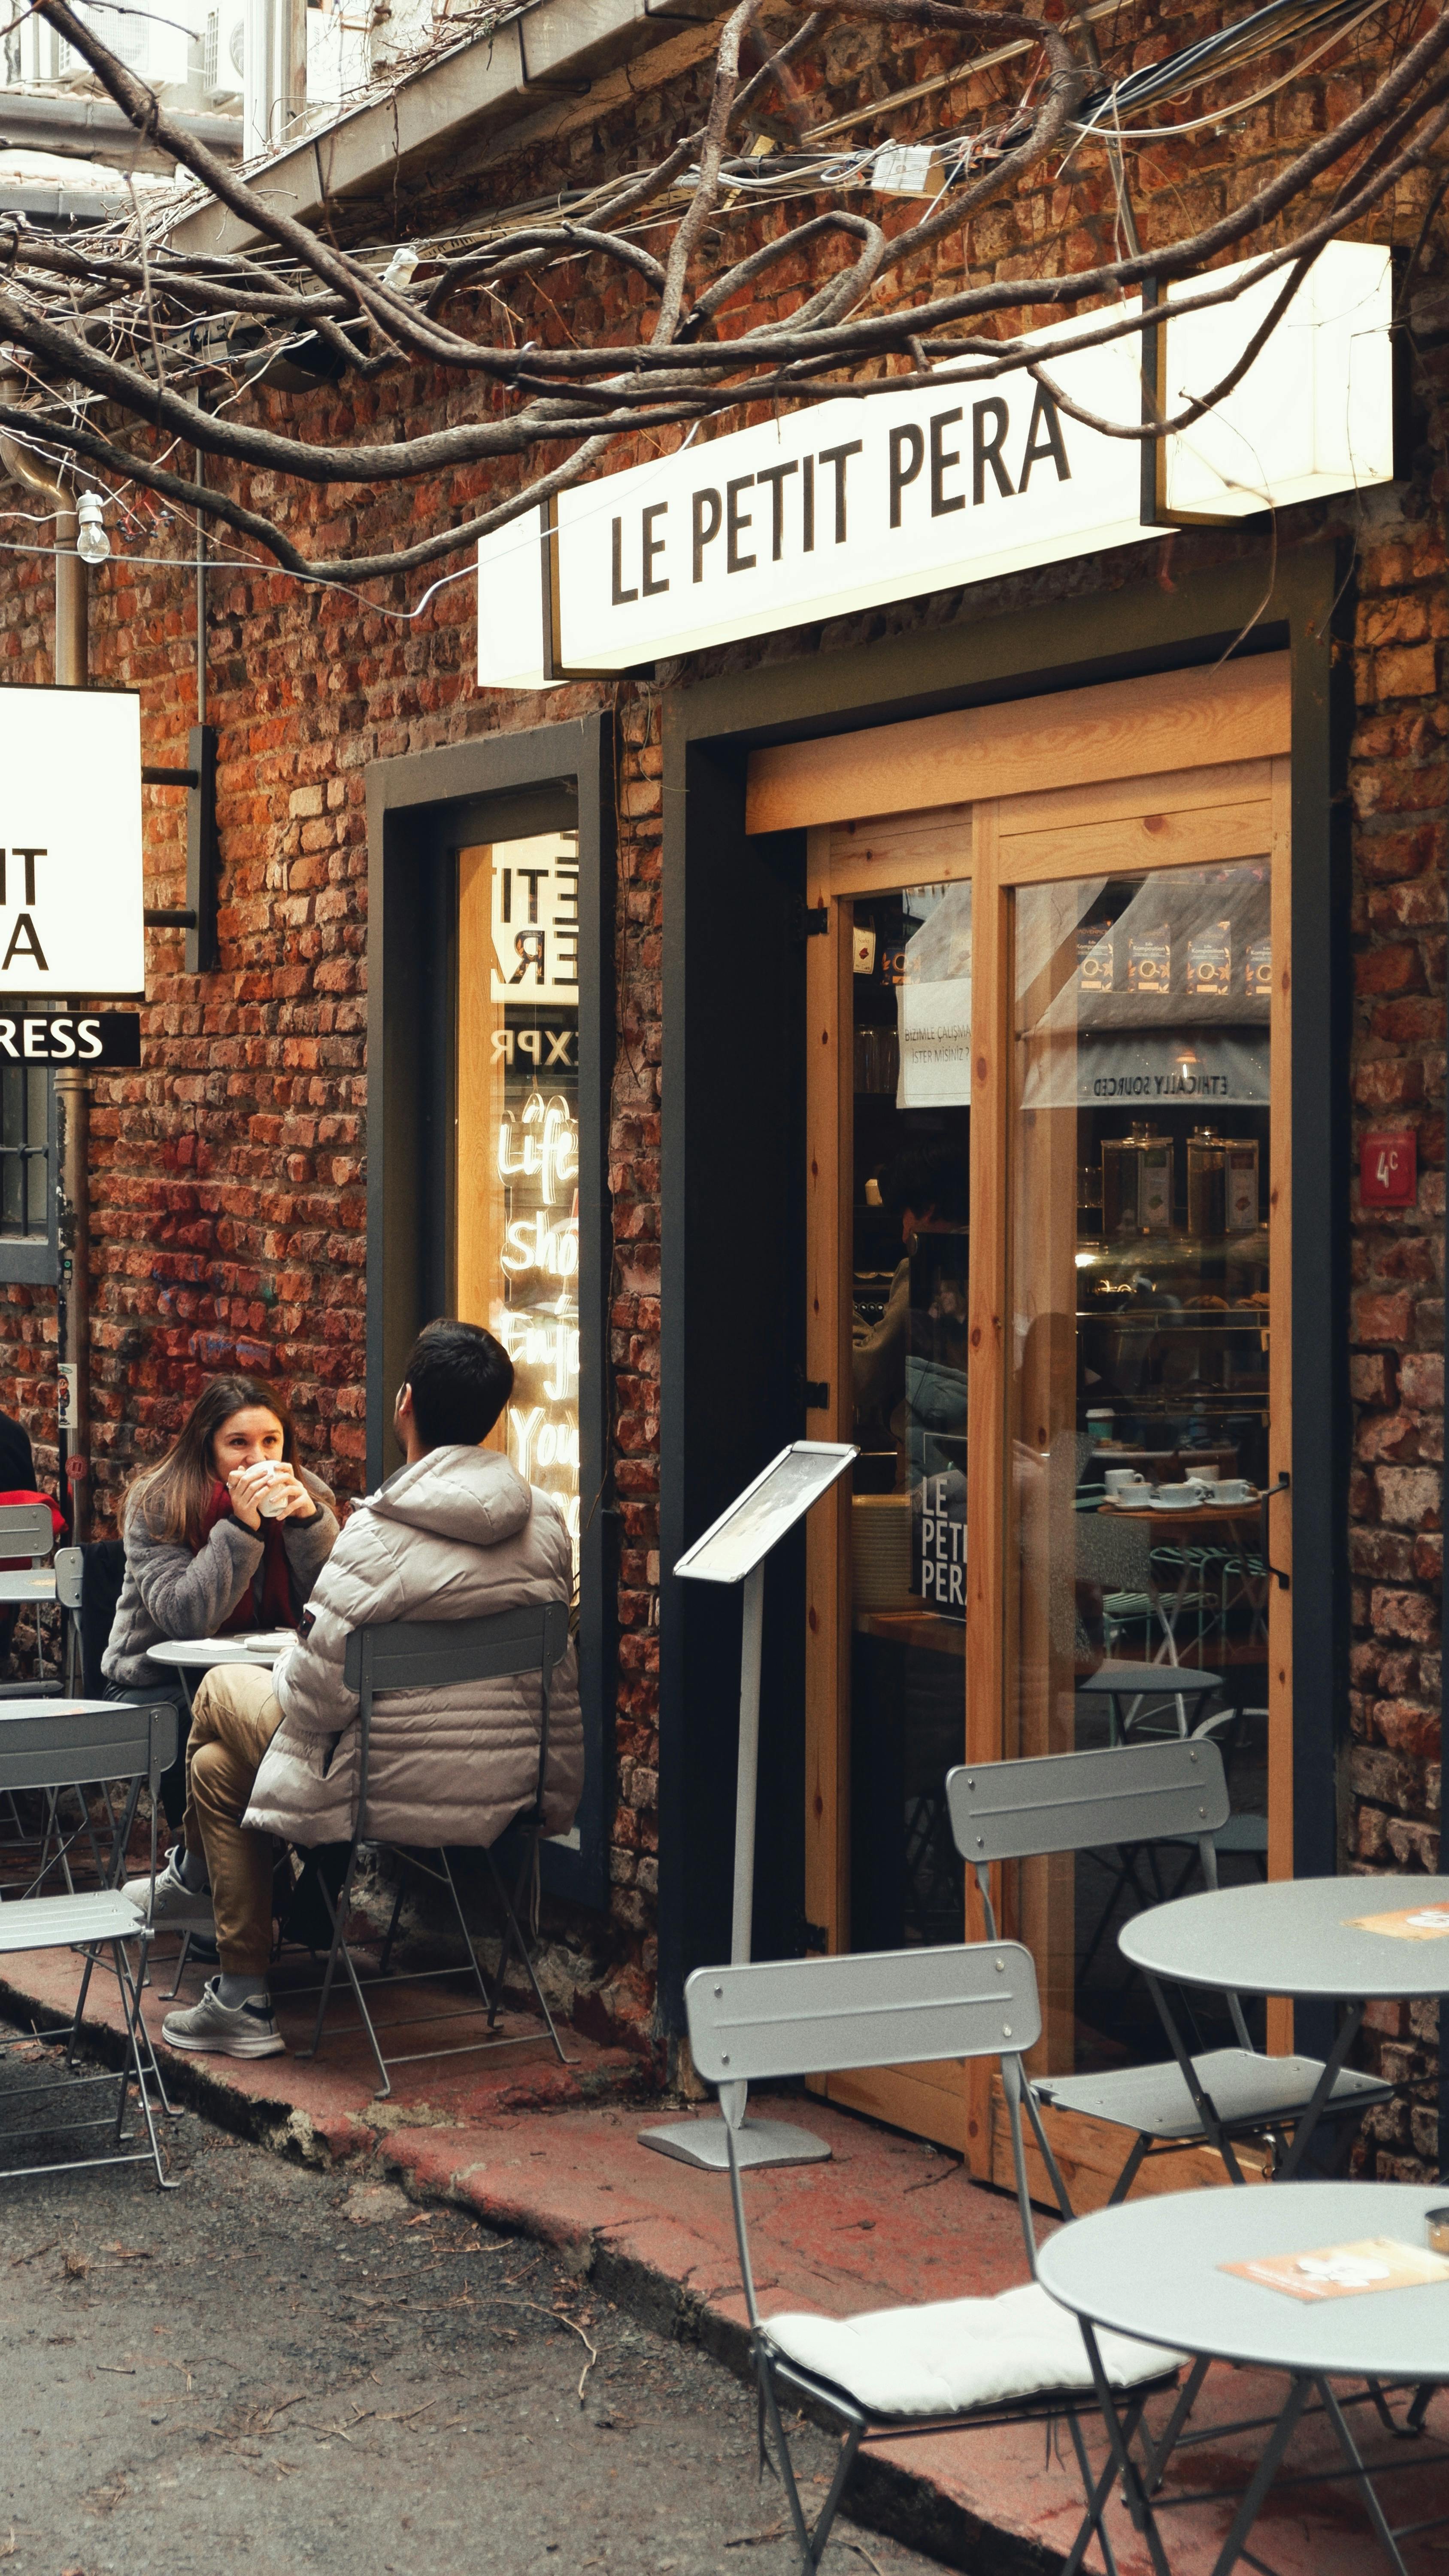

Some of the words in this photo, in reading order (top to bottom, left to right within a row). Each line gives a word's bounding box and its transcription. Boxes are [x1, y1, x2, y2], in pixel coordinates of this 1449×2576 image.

[611, 500, 670, 606] LE
[691, 439, 863, 583] PETIT
[889, 383, 1072, 528] PERA
[923, 1476, 948, 1518] LE
[922, 1559, 967, 1606] PER
